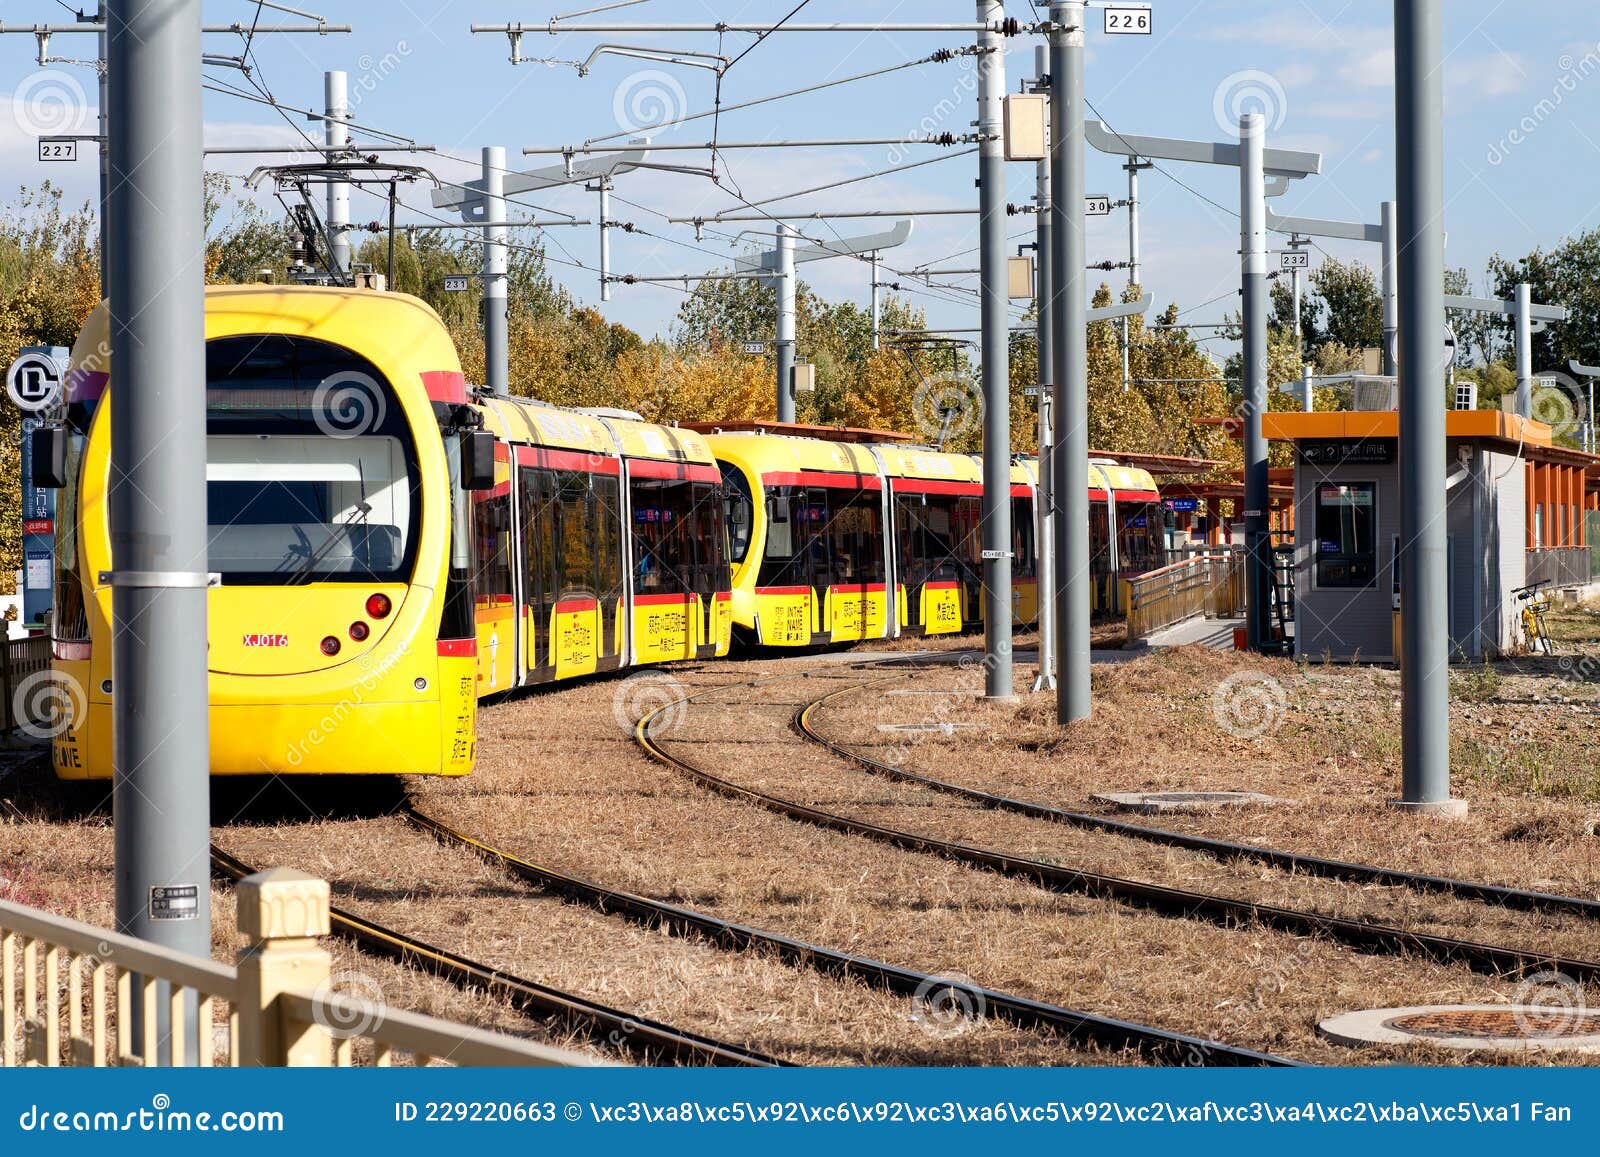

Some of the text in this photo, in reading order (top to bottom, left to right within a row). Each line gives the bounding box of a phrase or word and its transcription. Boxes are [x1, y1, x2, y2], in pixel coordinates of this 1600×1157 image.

[1109, 15, 1147, 28] 226
[42, 146, 72, 156] 227
[1283, 256, 1305, 264] 232
[446, 280, 465, 289] 231
[243, 634, 288, 646] XJ016
